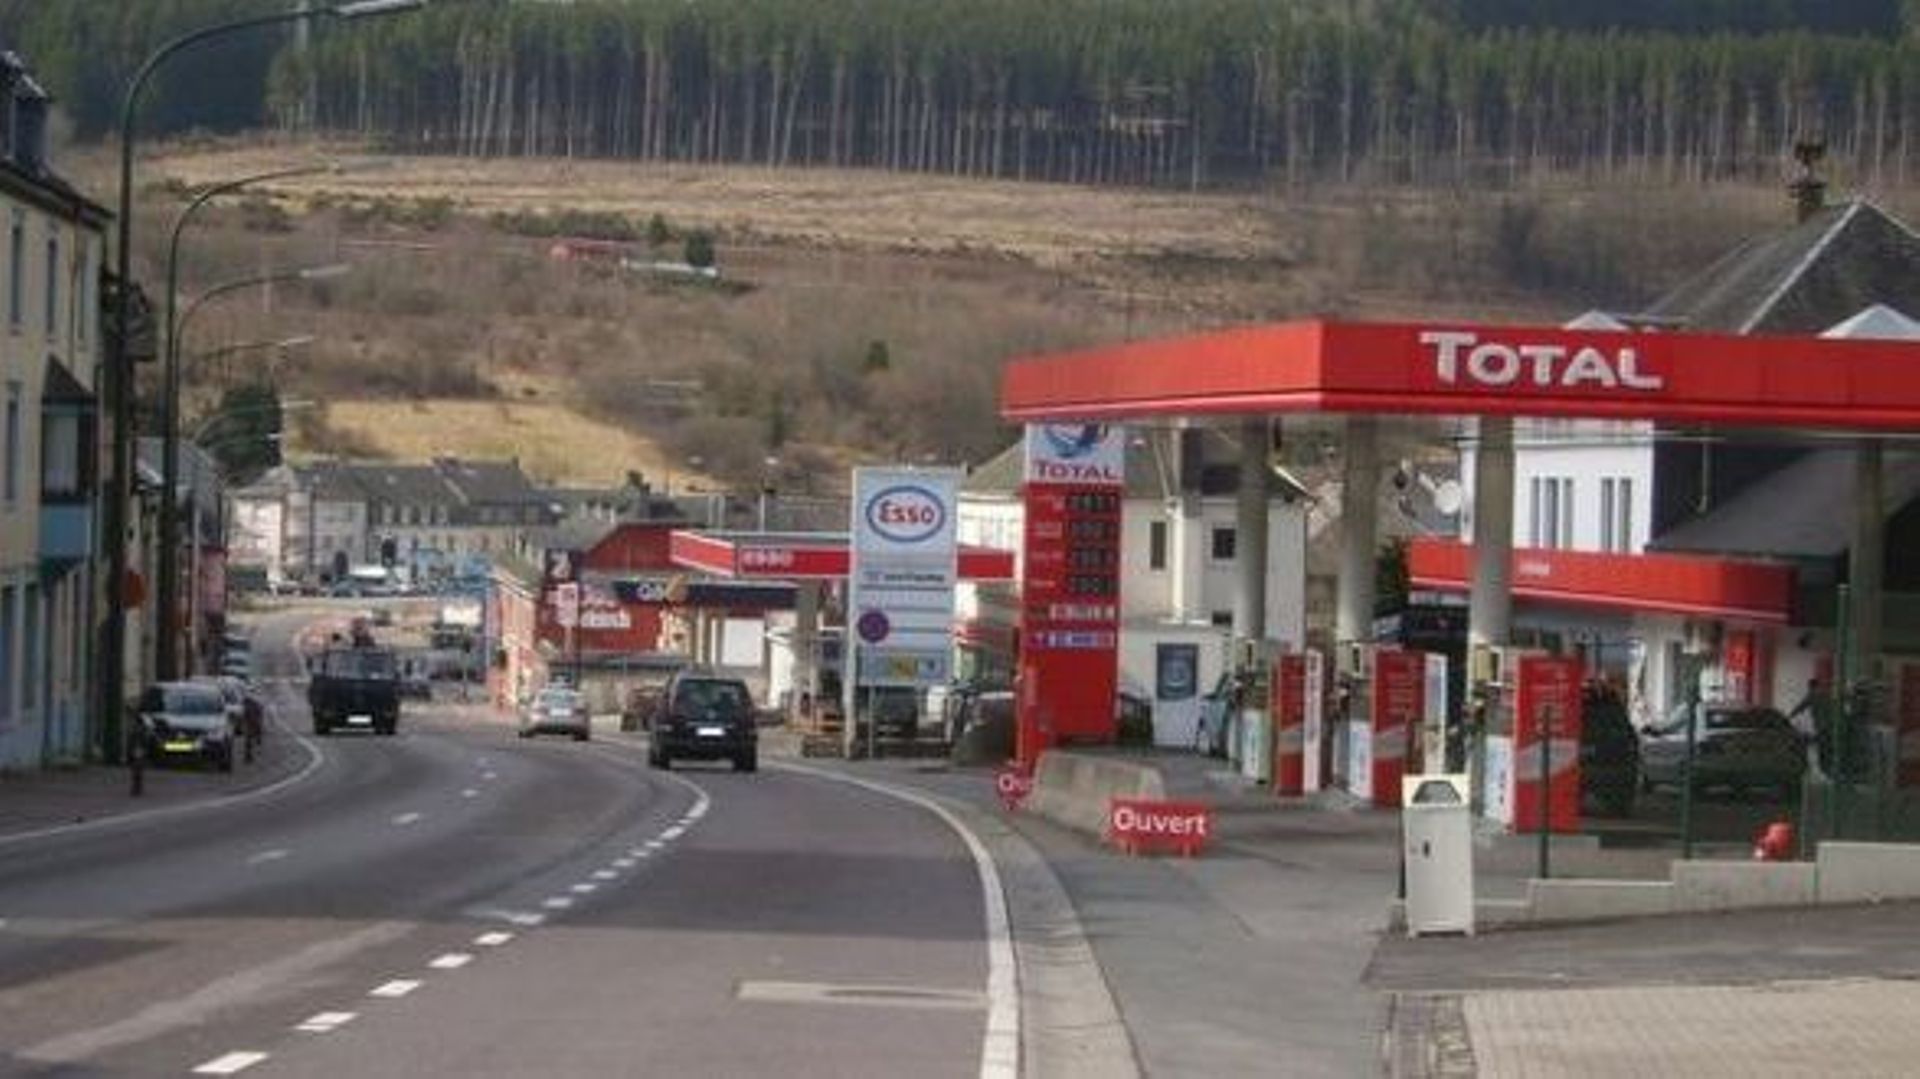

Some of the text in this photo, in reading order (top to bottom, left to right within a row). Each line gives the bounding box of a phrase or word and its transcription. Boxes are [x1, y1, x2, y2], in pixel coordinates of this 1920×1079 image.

[1419, 331, 1662, 390] TOTAL
[1035, 461, 1118, 480] TOTAL
[1113, 807, 1207, 835] Ouvert
